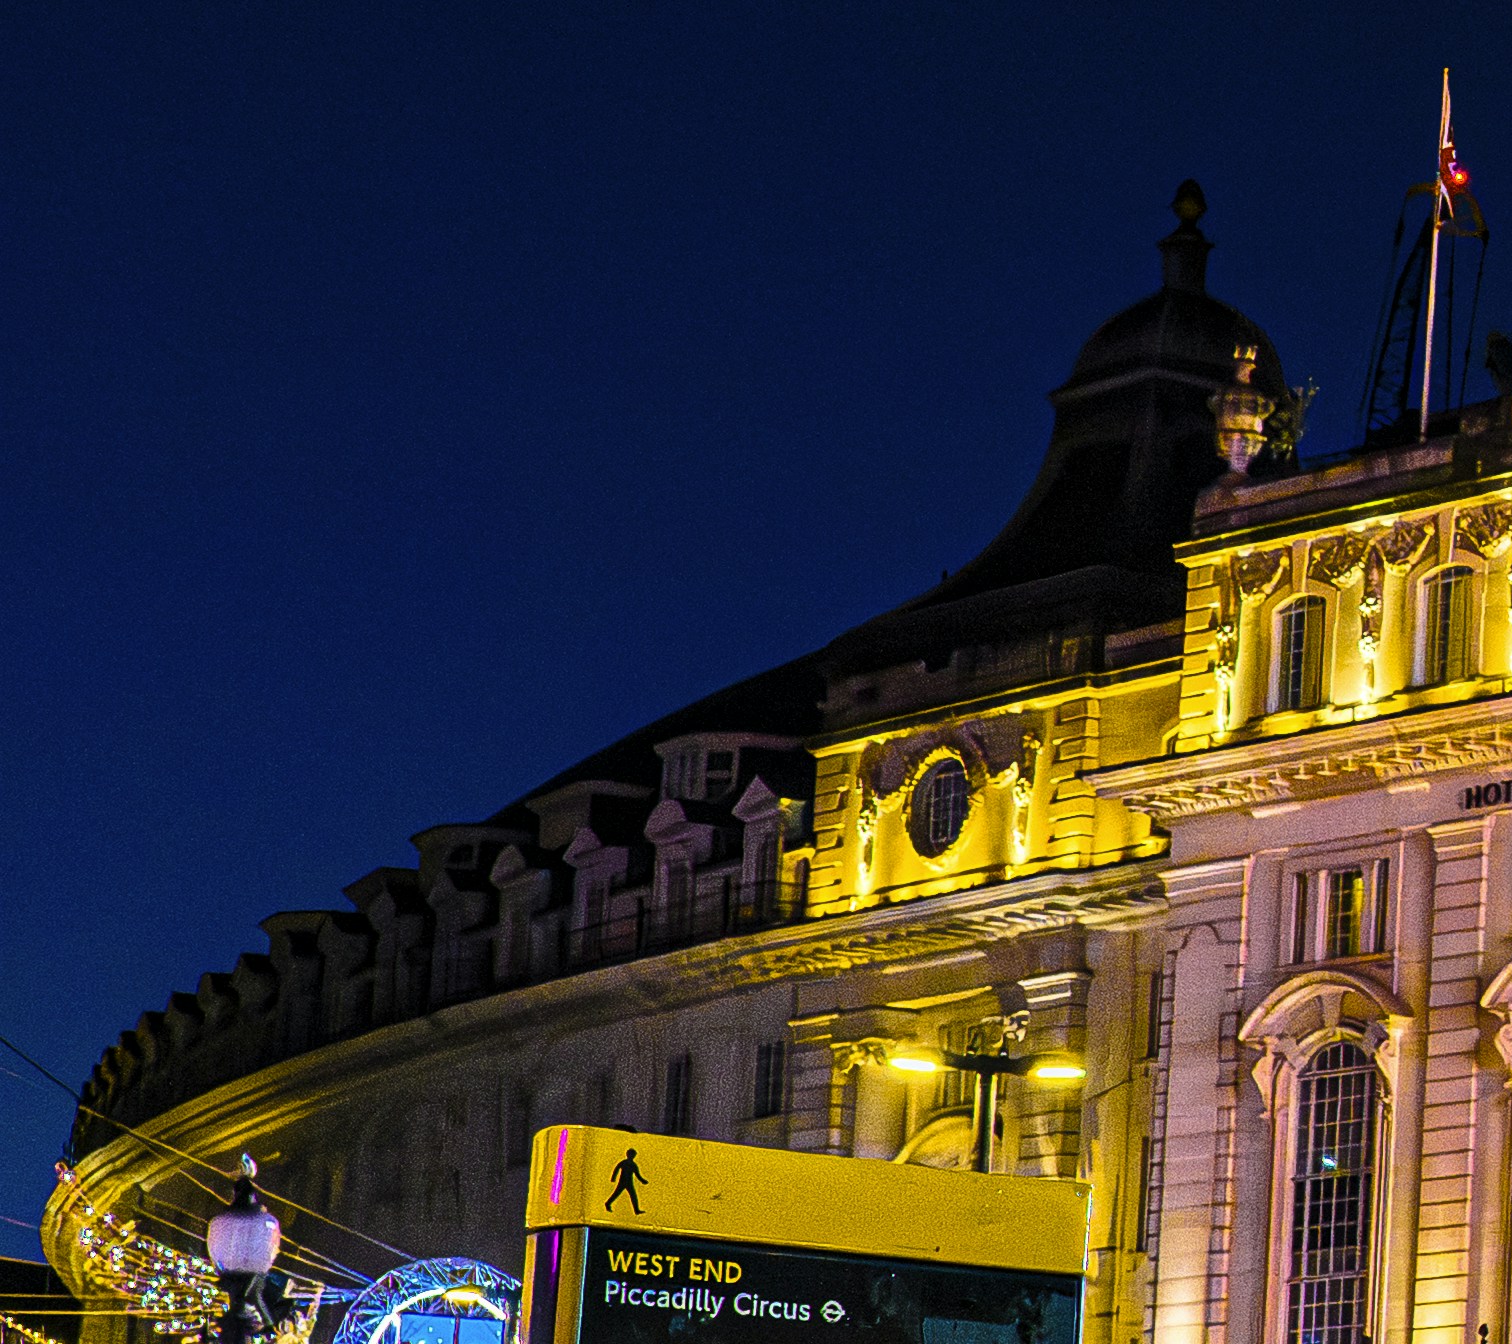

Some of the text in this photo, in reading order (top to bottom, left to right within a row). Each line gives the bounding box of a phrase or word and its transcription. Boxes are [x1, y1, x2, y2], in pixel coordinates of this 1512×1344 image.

[608, 1249, 742, 1284] WEST END
[604, 1280, 811, 1321] Piccadilly Circus
